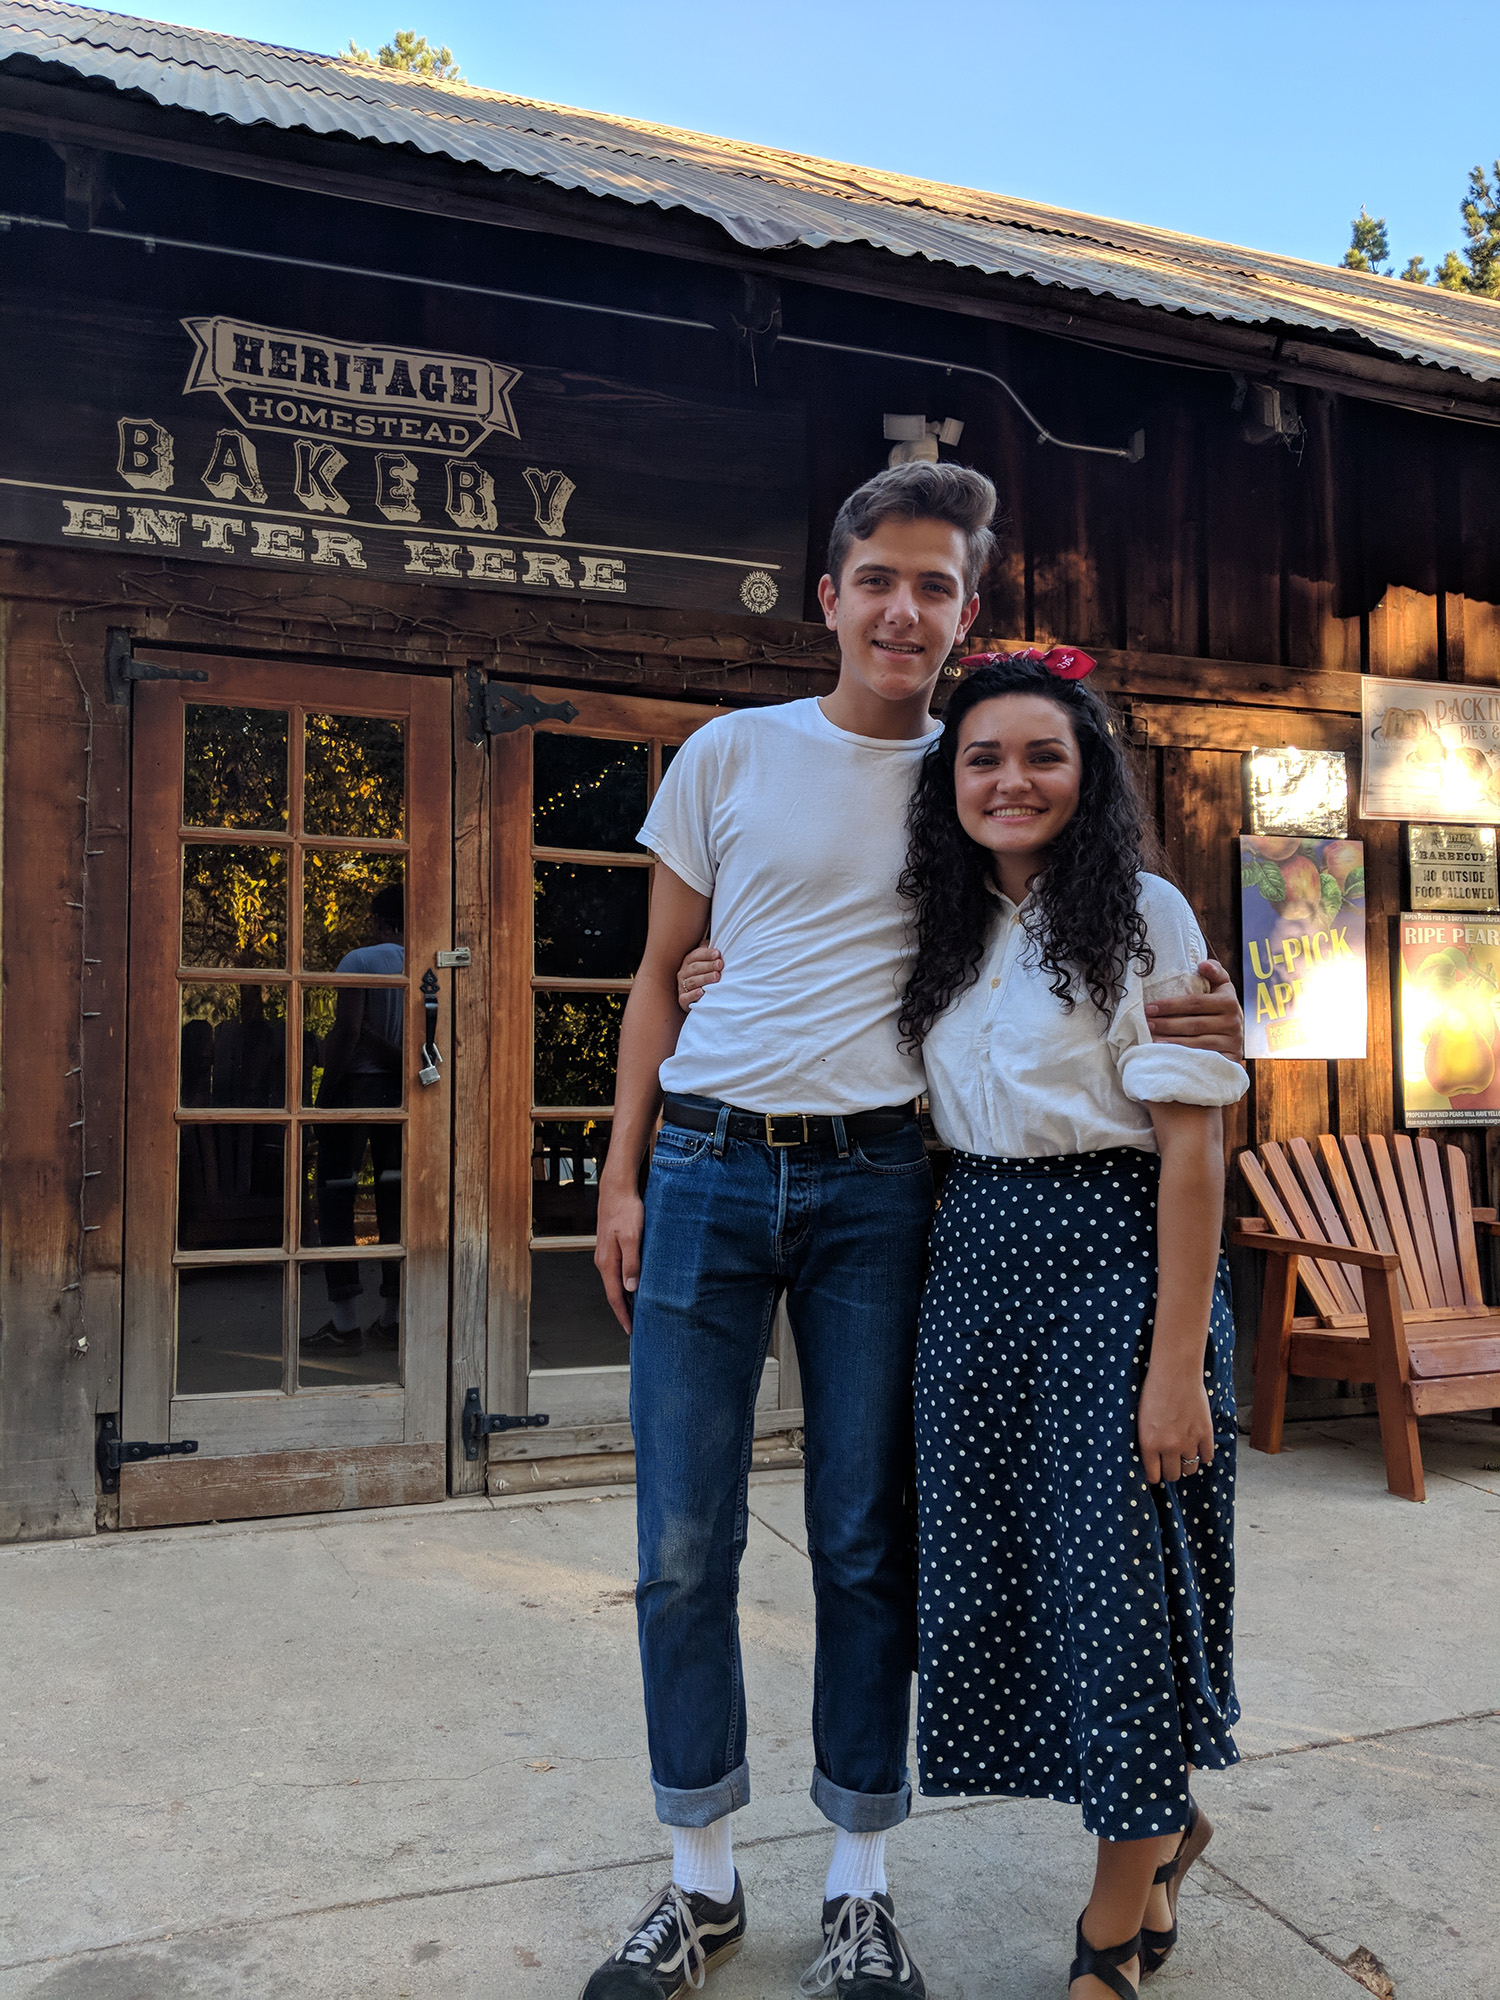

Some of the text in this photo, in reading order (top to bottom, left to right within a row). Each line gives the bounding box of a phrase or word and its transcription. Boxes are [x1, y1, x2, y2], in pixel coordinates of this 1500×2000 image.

[231, 332, 478, 407] HERITAGE
[248, 396, 470, 445] HOMESTEAD
[116, 416, 576, 538] BAKERY
[61, 499, 628, 593] ENTER HERE
[1460, 725, 1487, 744] PIES
[1419, 851, 1487, 862] BARBECUE
[1415, 886, 1495, 900] FOOD ALLOWED
[1423, 869, 1486, 883] NO OUTSIDE
[1249, 926, 1355, 980] U-PICK
[1404, 927, 1500, 946] RIPE PEAR
